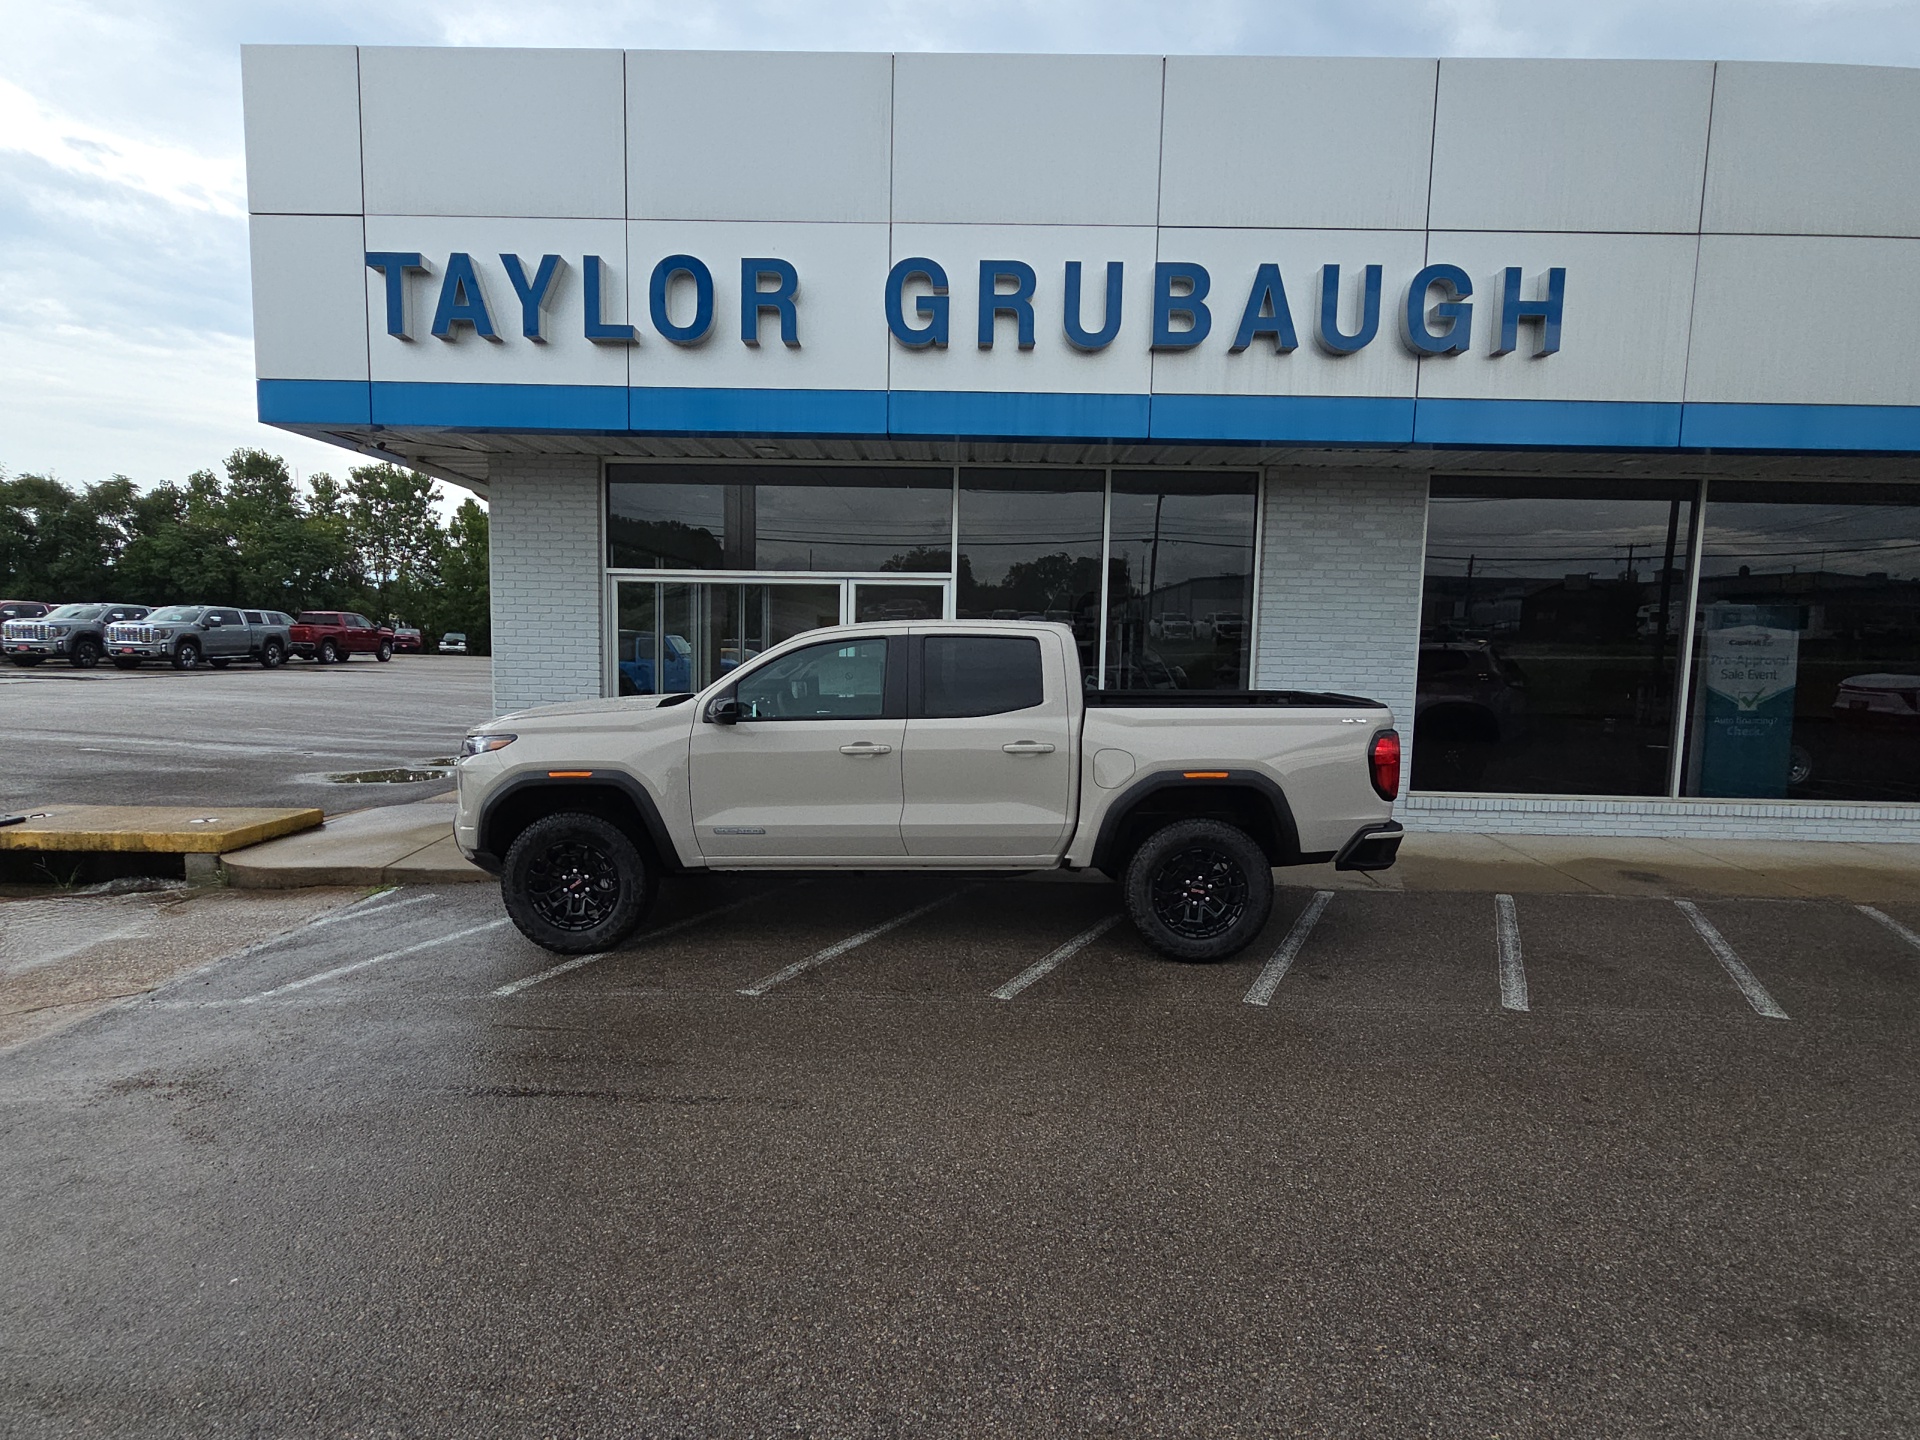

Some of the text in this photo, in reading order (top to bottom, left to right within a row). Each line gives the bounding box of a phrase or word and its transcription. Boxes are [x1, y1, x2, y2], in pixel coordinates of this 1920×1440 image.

[366, 252, 1567, 357] TAYLOR GRUBAUGH
[1711, 655, 1790, 667] Pre-Approval
[1720, 669, 1778, 680] Sale Event
[1714, 716, 1735, 724] Auto
